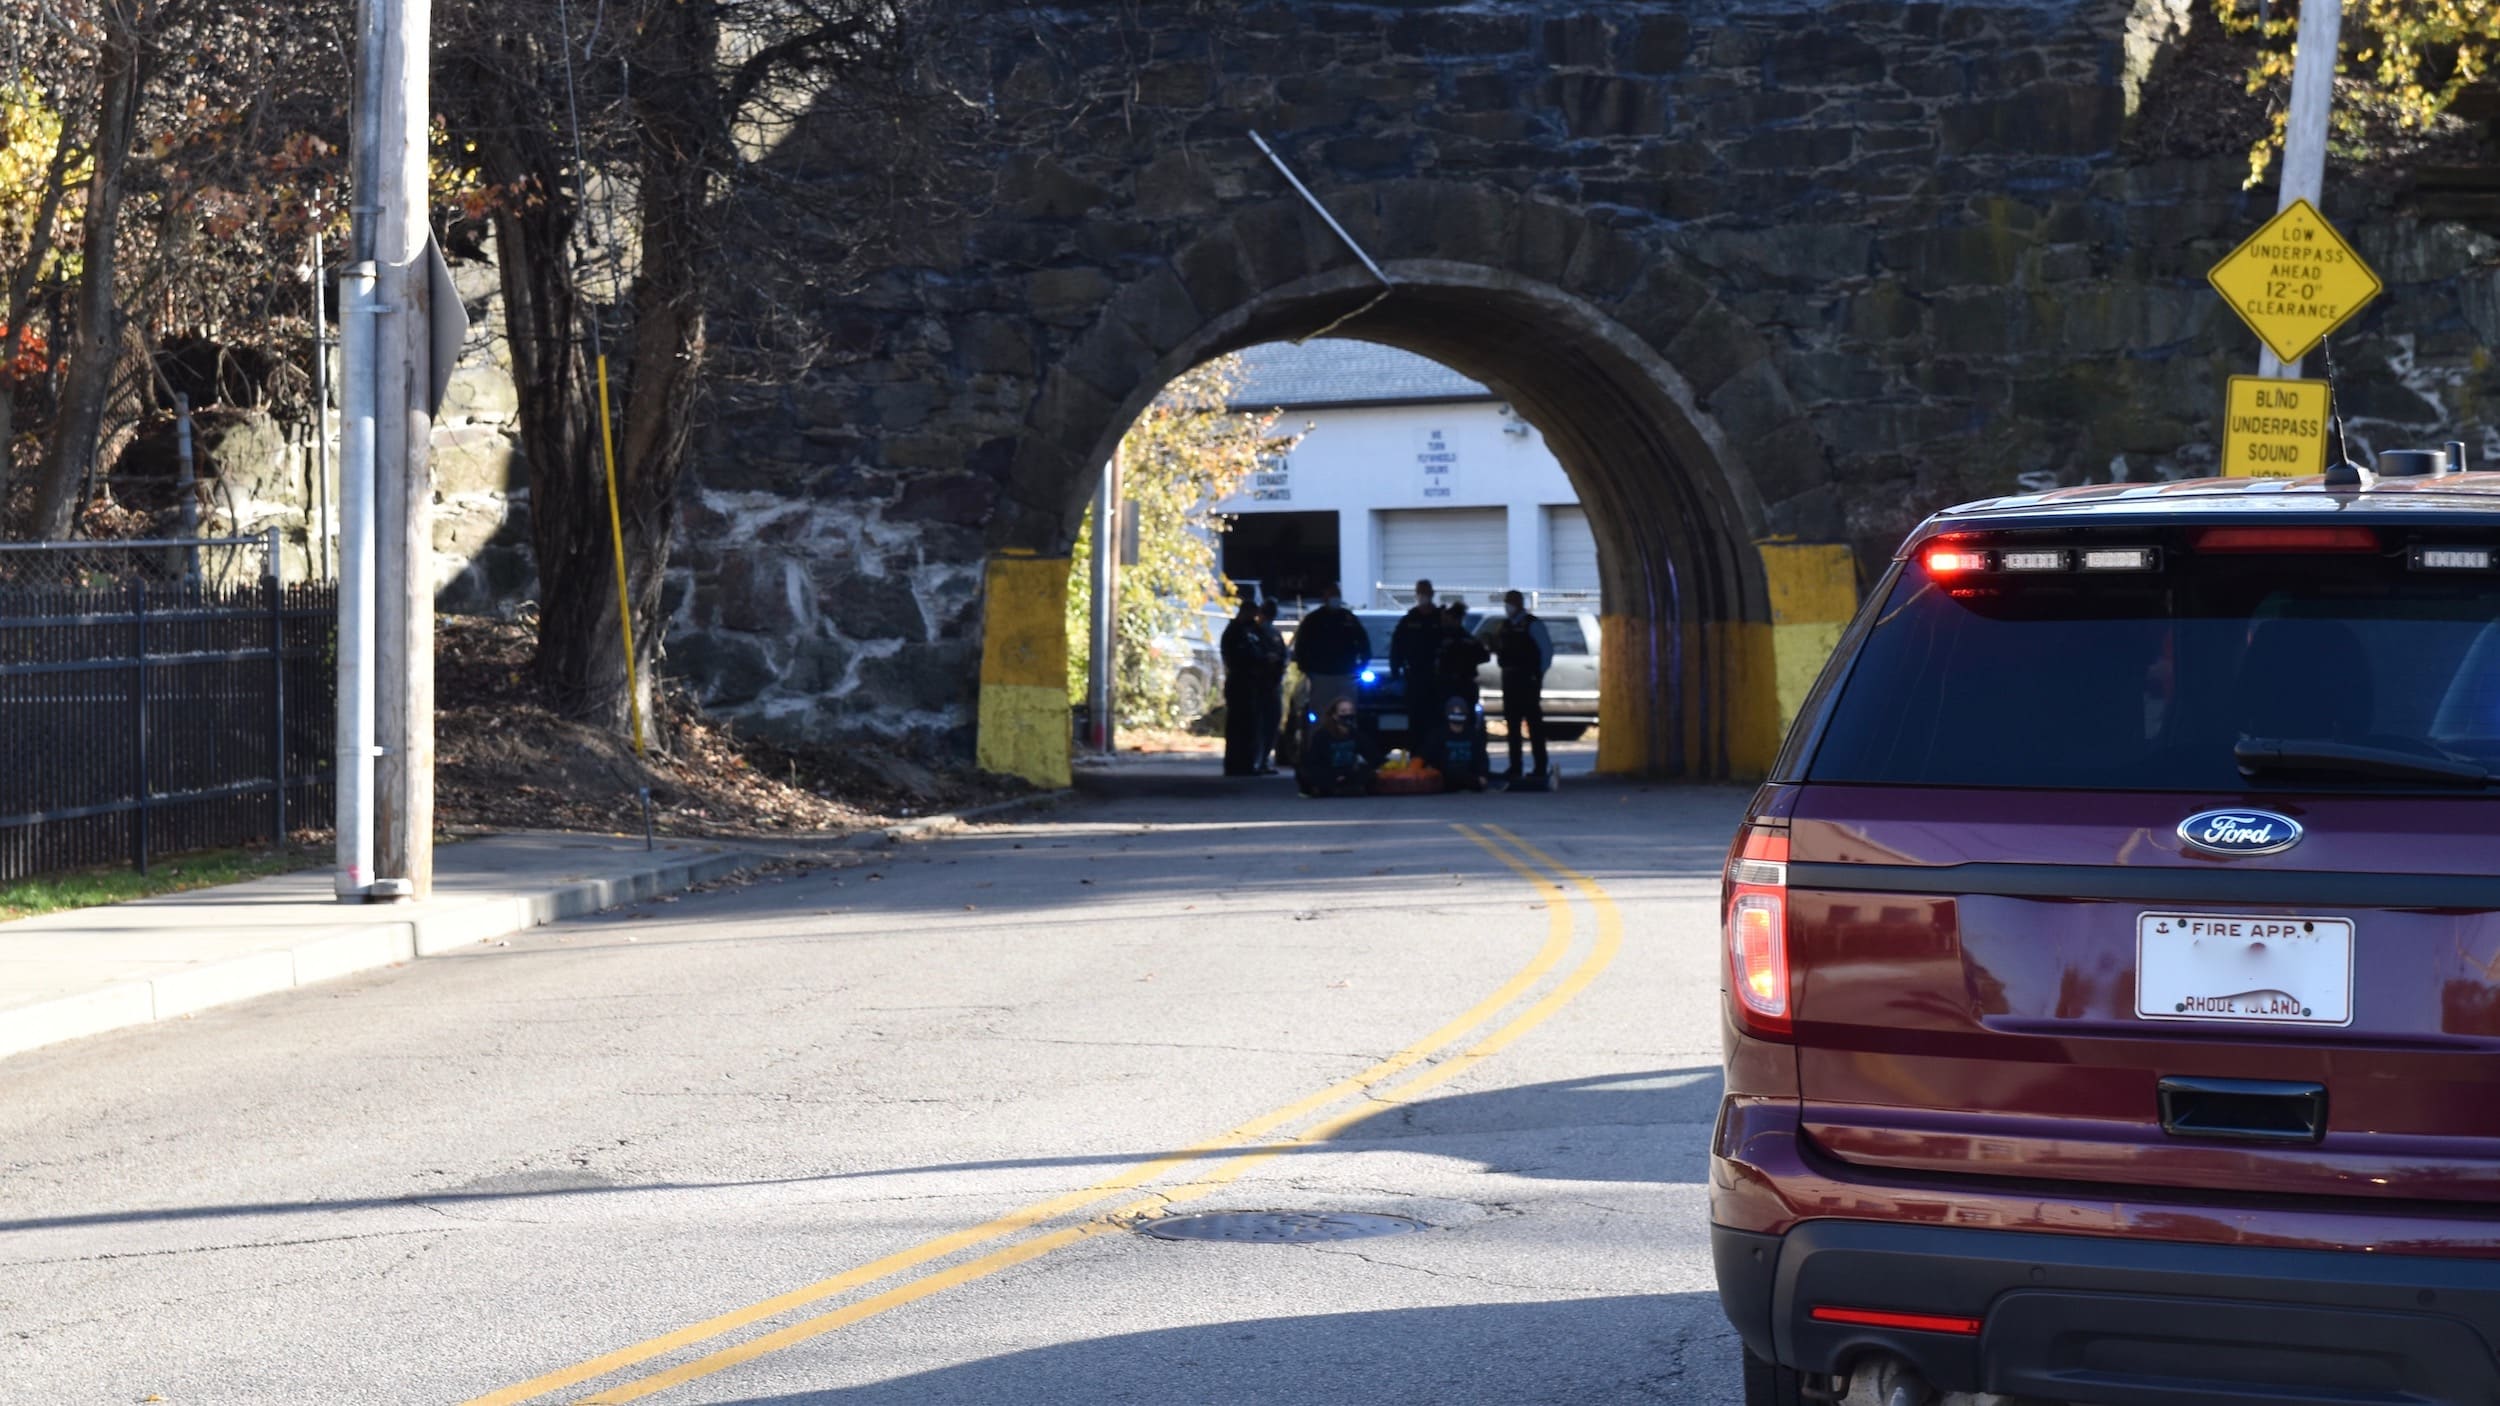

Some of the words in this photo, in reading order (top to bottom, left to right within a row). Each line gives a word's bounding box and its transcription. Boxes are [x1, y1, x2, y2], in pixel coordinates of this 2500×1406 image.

[2282, 227, 2314, 242] LOW
[2250, 245, 2343, 263] UNDERPASS
[2270, 264, 2321, 280] AHEAD
[2247, 300, 2337, 319] CLEARANCE
[2256, 388, 2298, 409] BLIND
[2232, 415, 2318, 437] UNDERPASS
[2248, 442, 2299, 463] SOUND
[2203, 815, 2272, 844] Ford
[2191, 922, 2242, 937] FIRE
[2250, 924, 2301, 939] APP.
